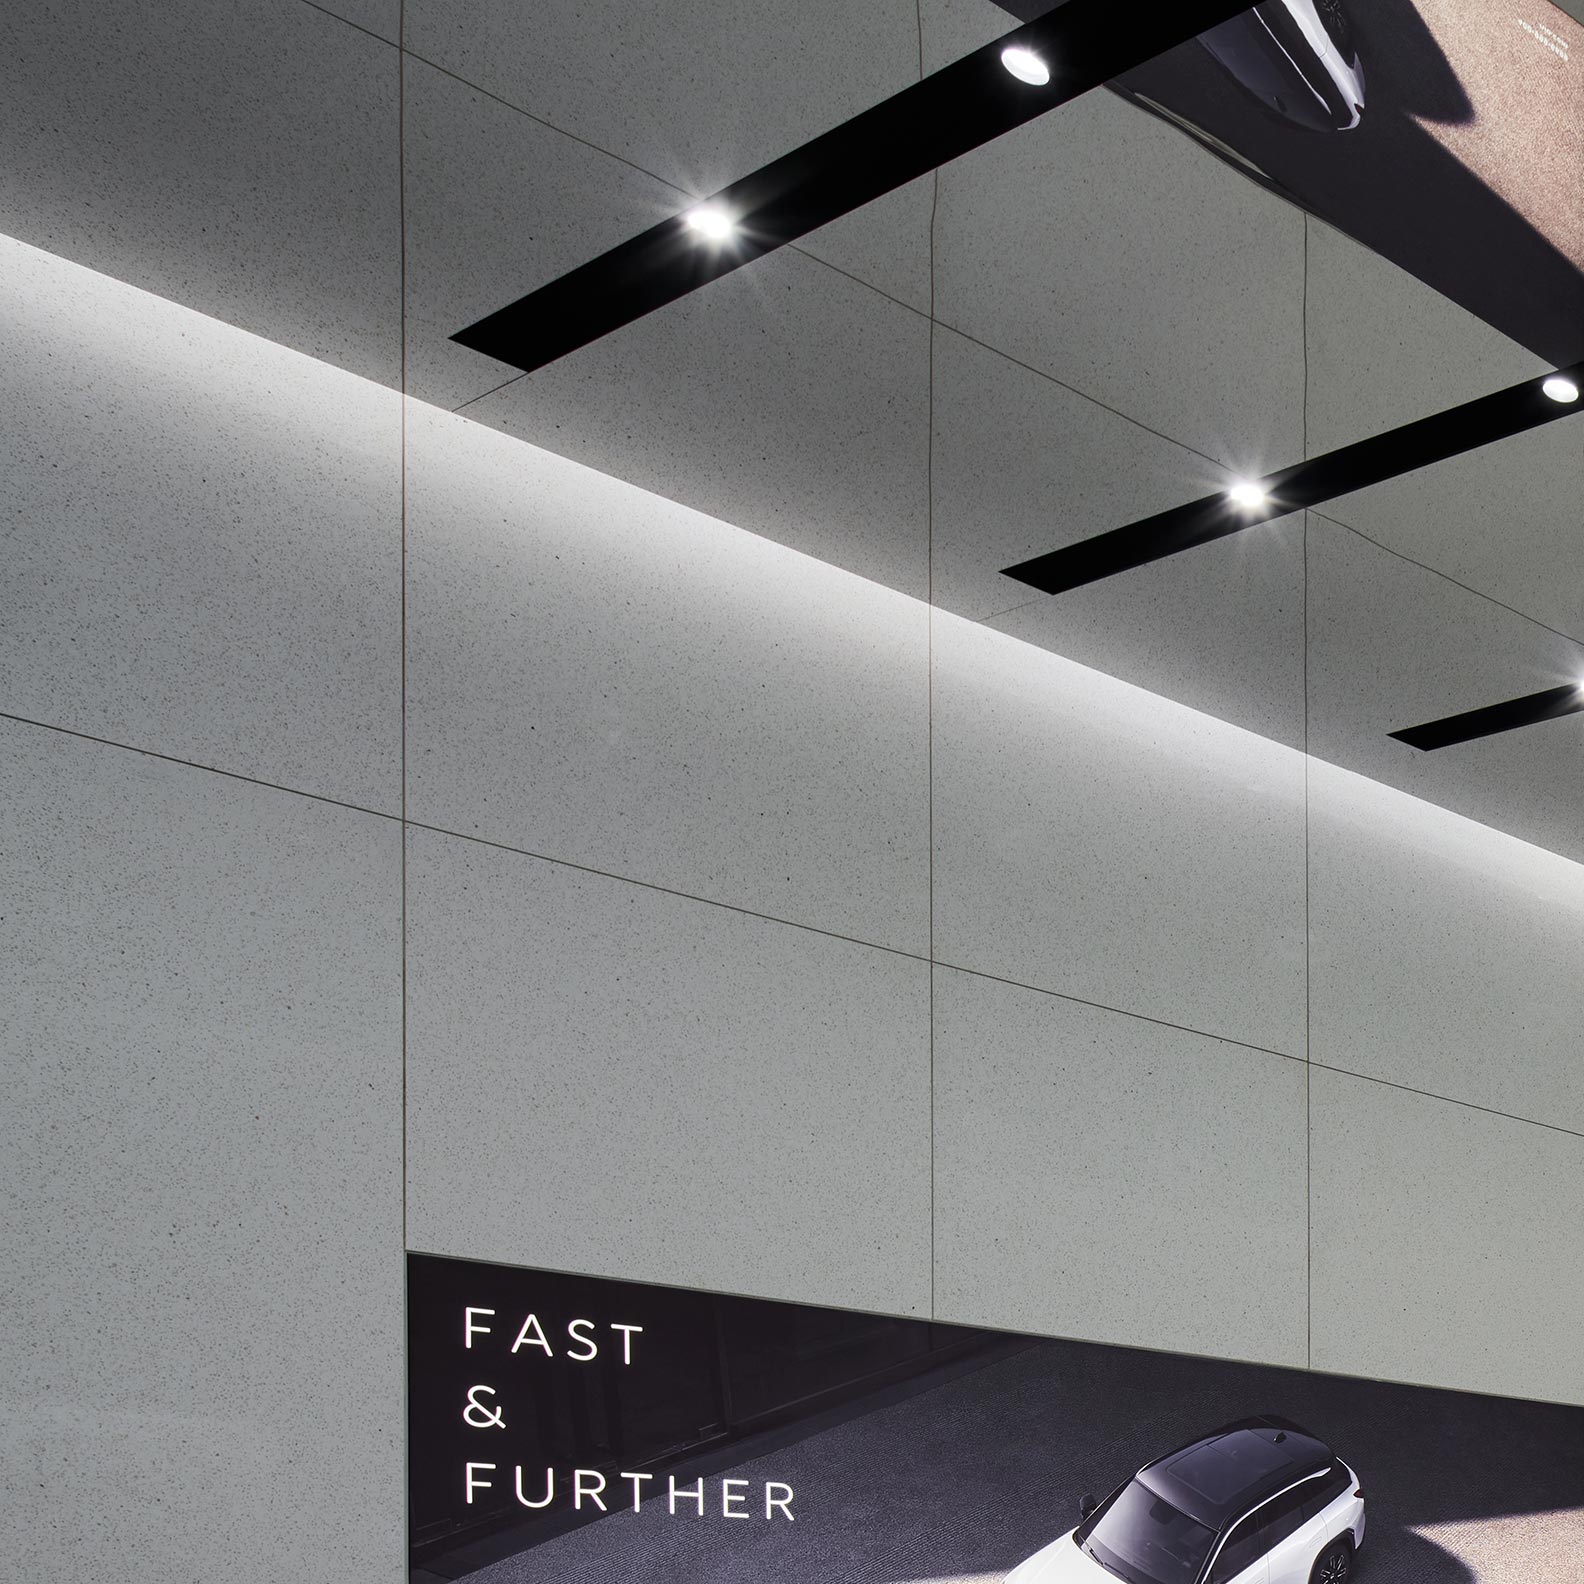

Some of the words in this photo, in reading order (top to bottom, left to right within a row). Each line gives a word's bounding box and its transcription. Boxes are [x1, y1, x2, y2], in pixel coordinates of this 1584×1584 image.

[465, 1306, 644, 1366] FAST
[462, 1384, 507, 1430] &
[465, 1461, 796, 1522] FURTHER
